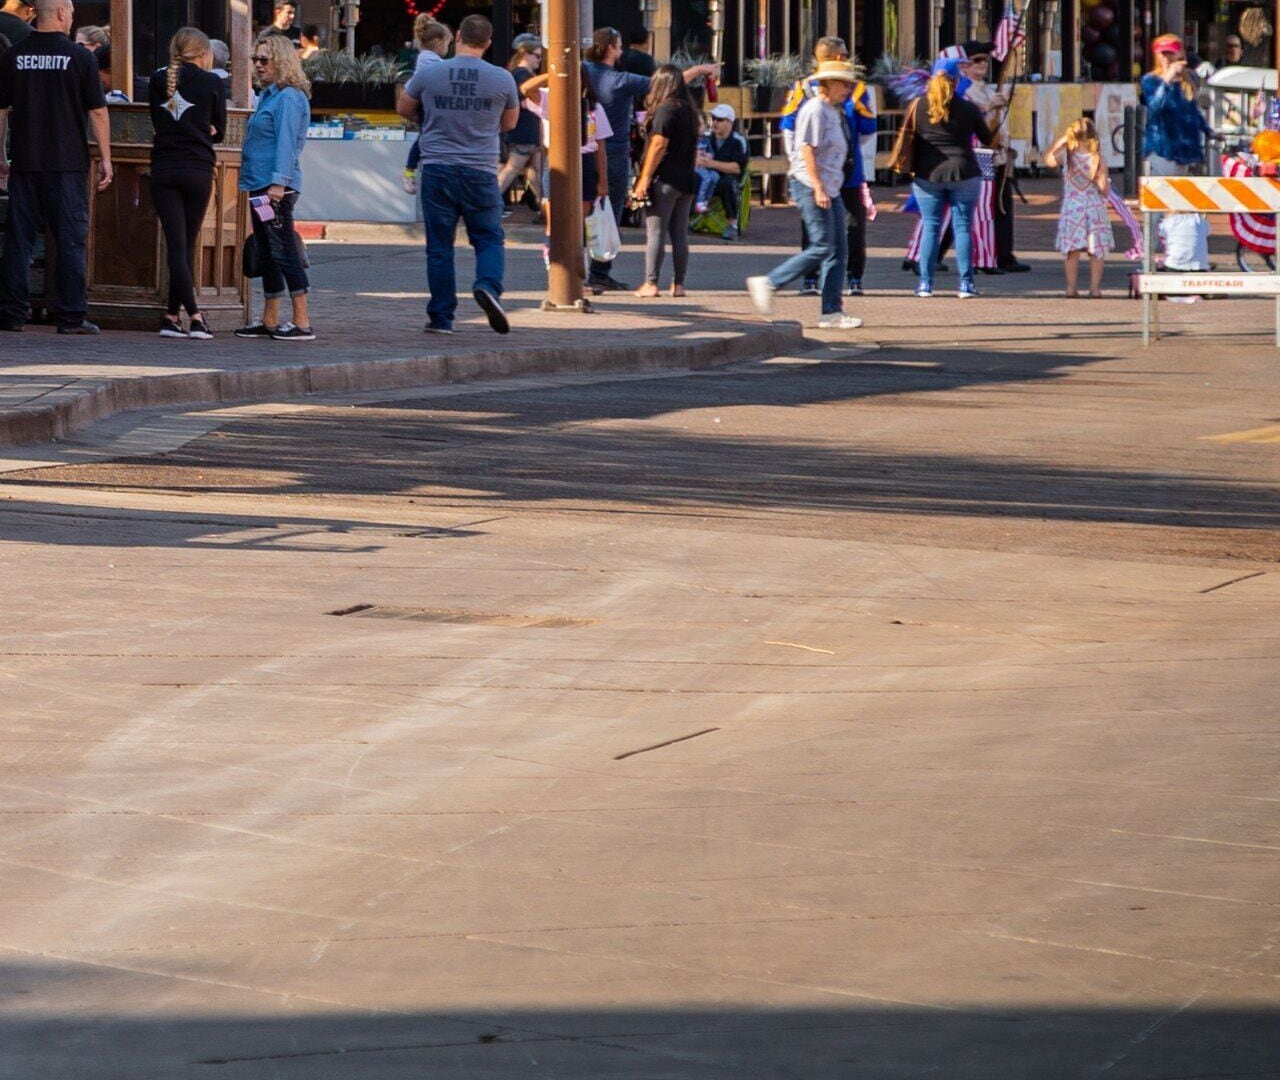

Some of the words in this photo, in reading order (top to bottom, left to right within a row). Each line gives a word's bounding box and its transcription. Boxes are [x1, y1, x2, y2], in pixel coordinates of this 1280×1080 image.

[16, 55, 71, 70] SECURITY
[449, 68, 454, 81] I
[458, 68, 480, 81] AM
[451, 82, 477, 96] THE
[434, 95, 492, 111] WEAPON
